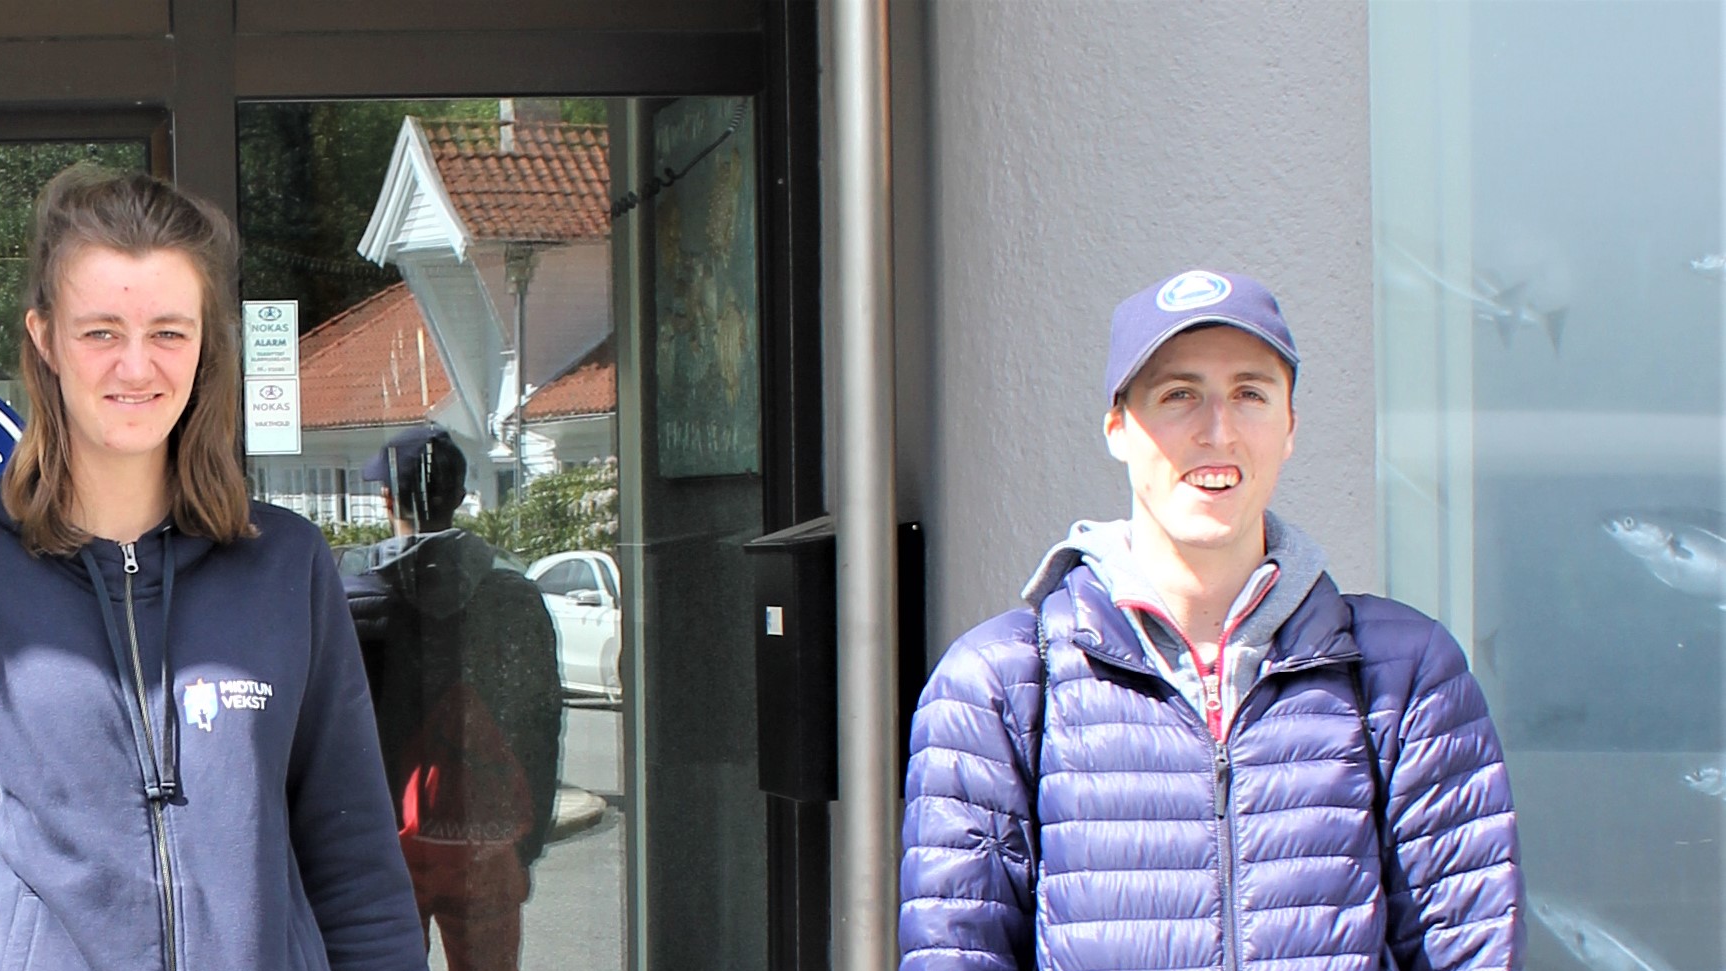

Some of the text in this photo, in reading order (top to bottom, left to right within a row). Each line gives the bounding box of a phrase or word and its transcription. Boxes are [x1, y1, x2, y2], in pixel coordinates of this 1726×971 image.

[251, 323, 289, 333] NOKAS
[254, 338, 287, 347] ALARM
[252, 402, 290, 411] NOKAS
[219, 680, 273, 697] MIDTUN
[221, 695, 267, 710] VEKST
